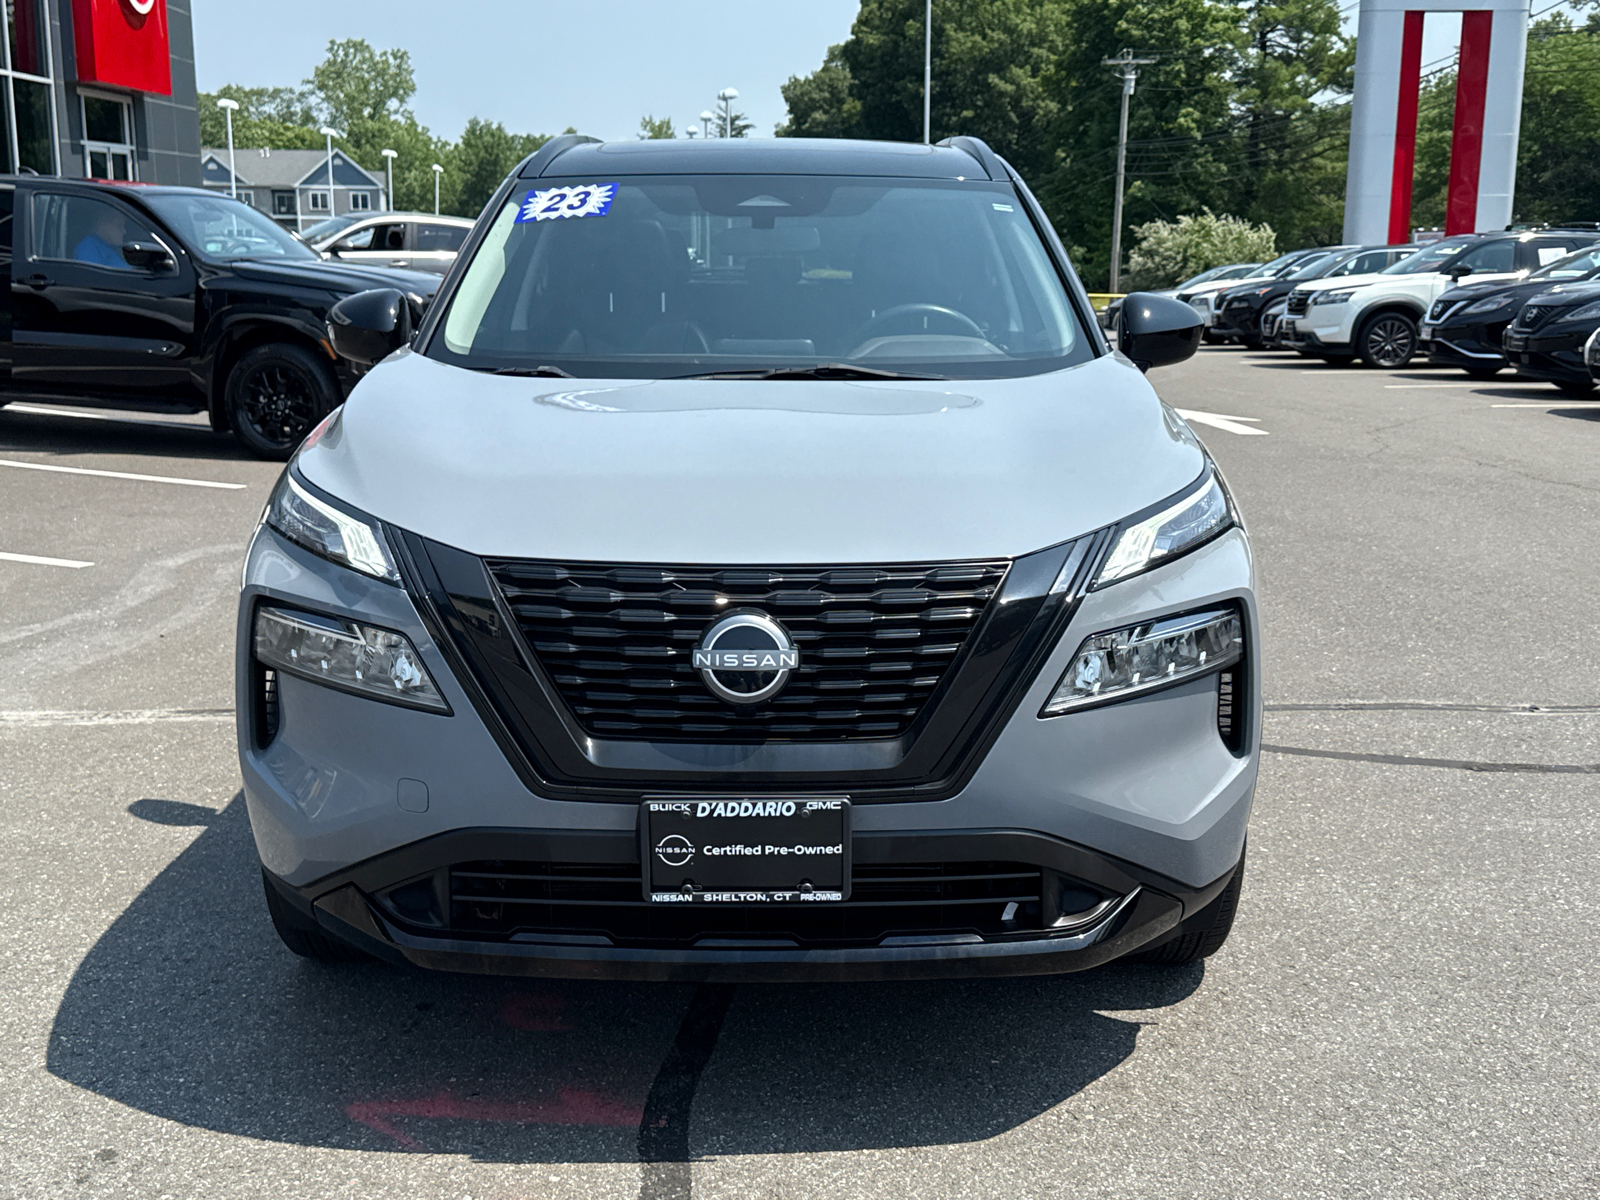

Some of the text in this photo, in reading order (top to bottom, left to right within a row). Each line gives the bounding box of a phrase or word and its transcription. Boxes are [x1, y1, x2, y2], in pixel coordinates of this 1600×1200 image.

[540, 191, 592, 213] 23
[696, 653, 796, 667] NISSAN
[650, 801, 842, 818] BUICK D'ADDARIO GMC
[703, 844, 842, 856] Certified Pre-Owned
[652, 894, 693, 902] NISSAN
[703, 893, 792, 902] SHELTON, CT
[801, 893, 842, 901] PRE-OWNED
